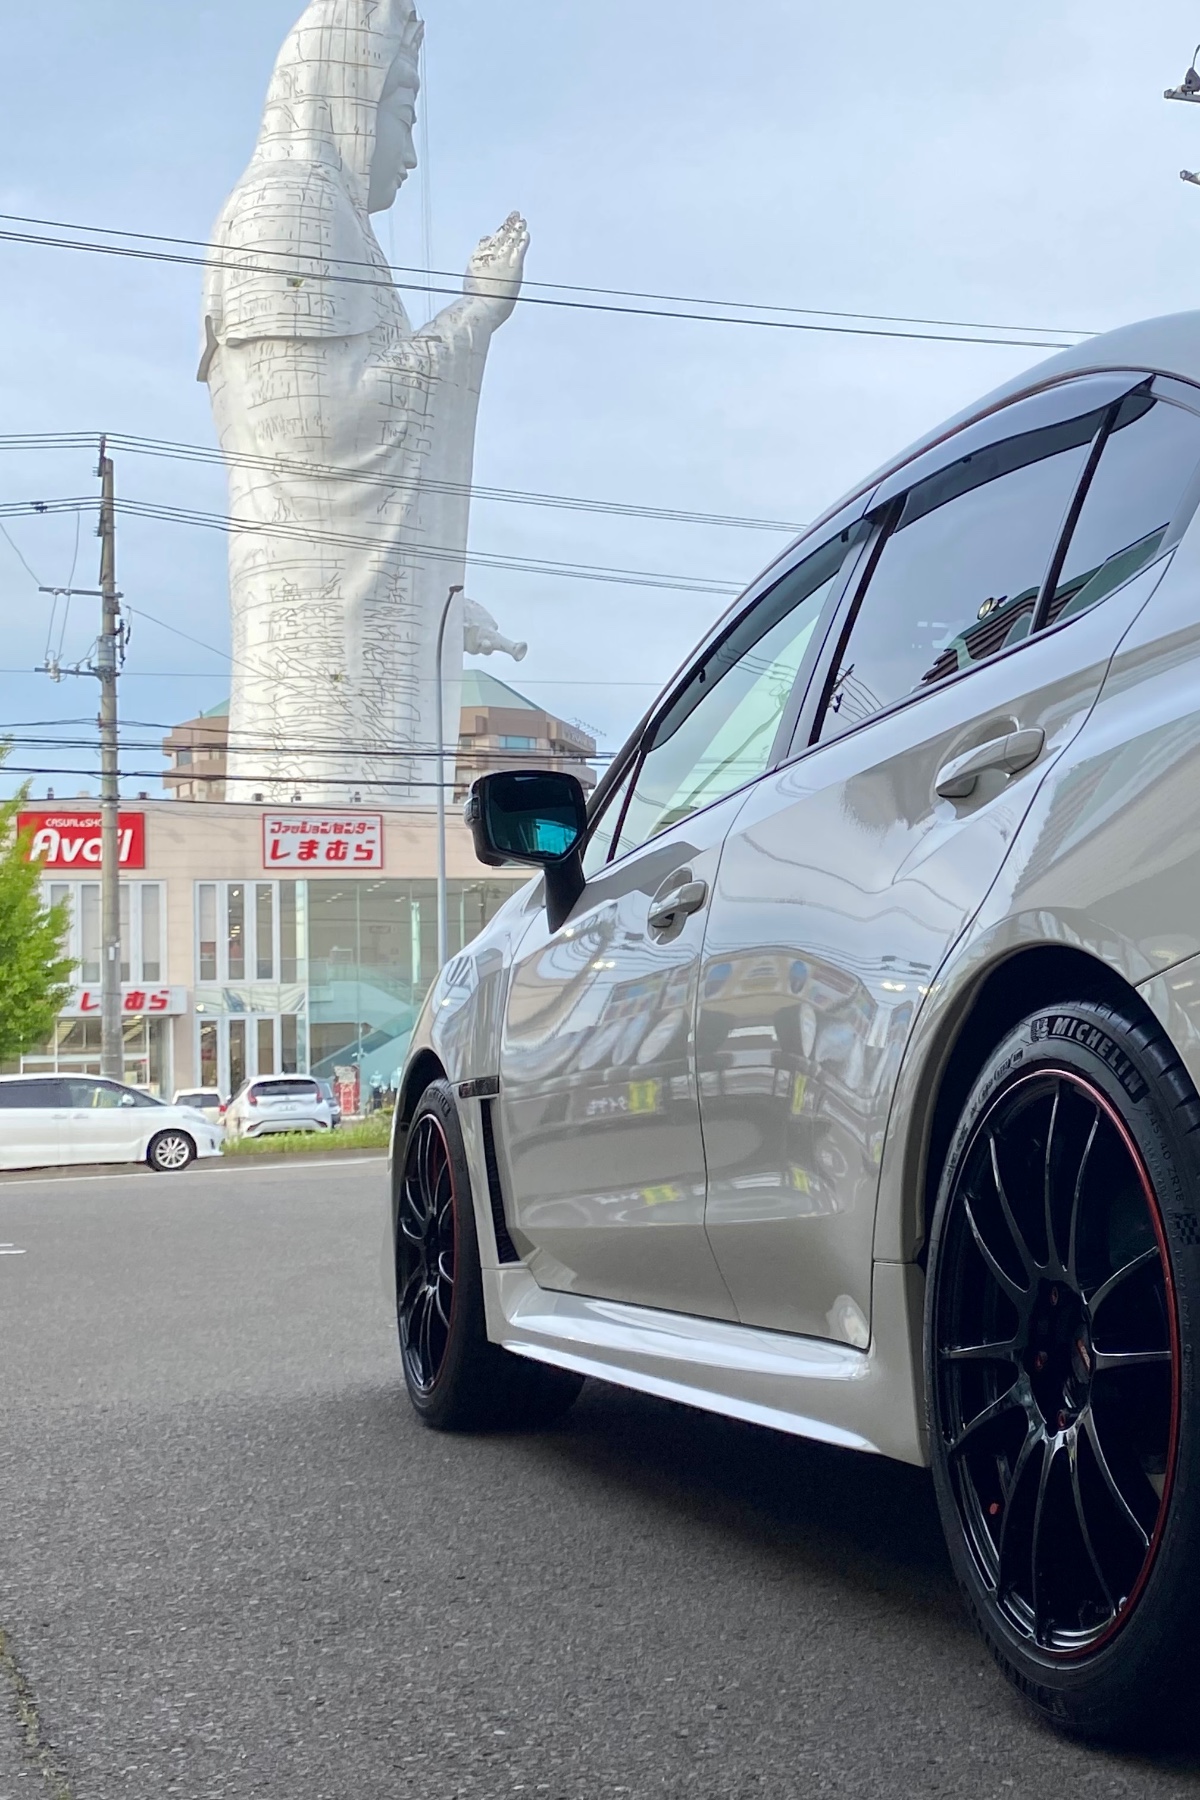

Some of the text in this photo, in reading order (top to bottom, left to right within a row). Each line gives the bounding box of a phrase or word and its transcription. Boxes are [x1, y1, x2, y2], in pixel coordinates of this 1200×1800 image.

[270, 821, 376, 834] ファッションセンター
[30, 828, 133, 862] Aval
[270, 839, 376, 861] しまむら
[80, 990, 169, 1011] しむら
[1052, 1016, 1147, 1094] MICHELIN
[1144, 1109, 1172, 1161] 245/40
[1166, 1164, 1186, 1202] ZR18
